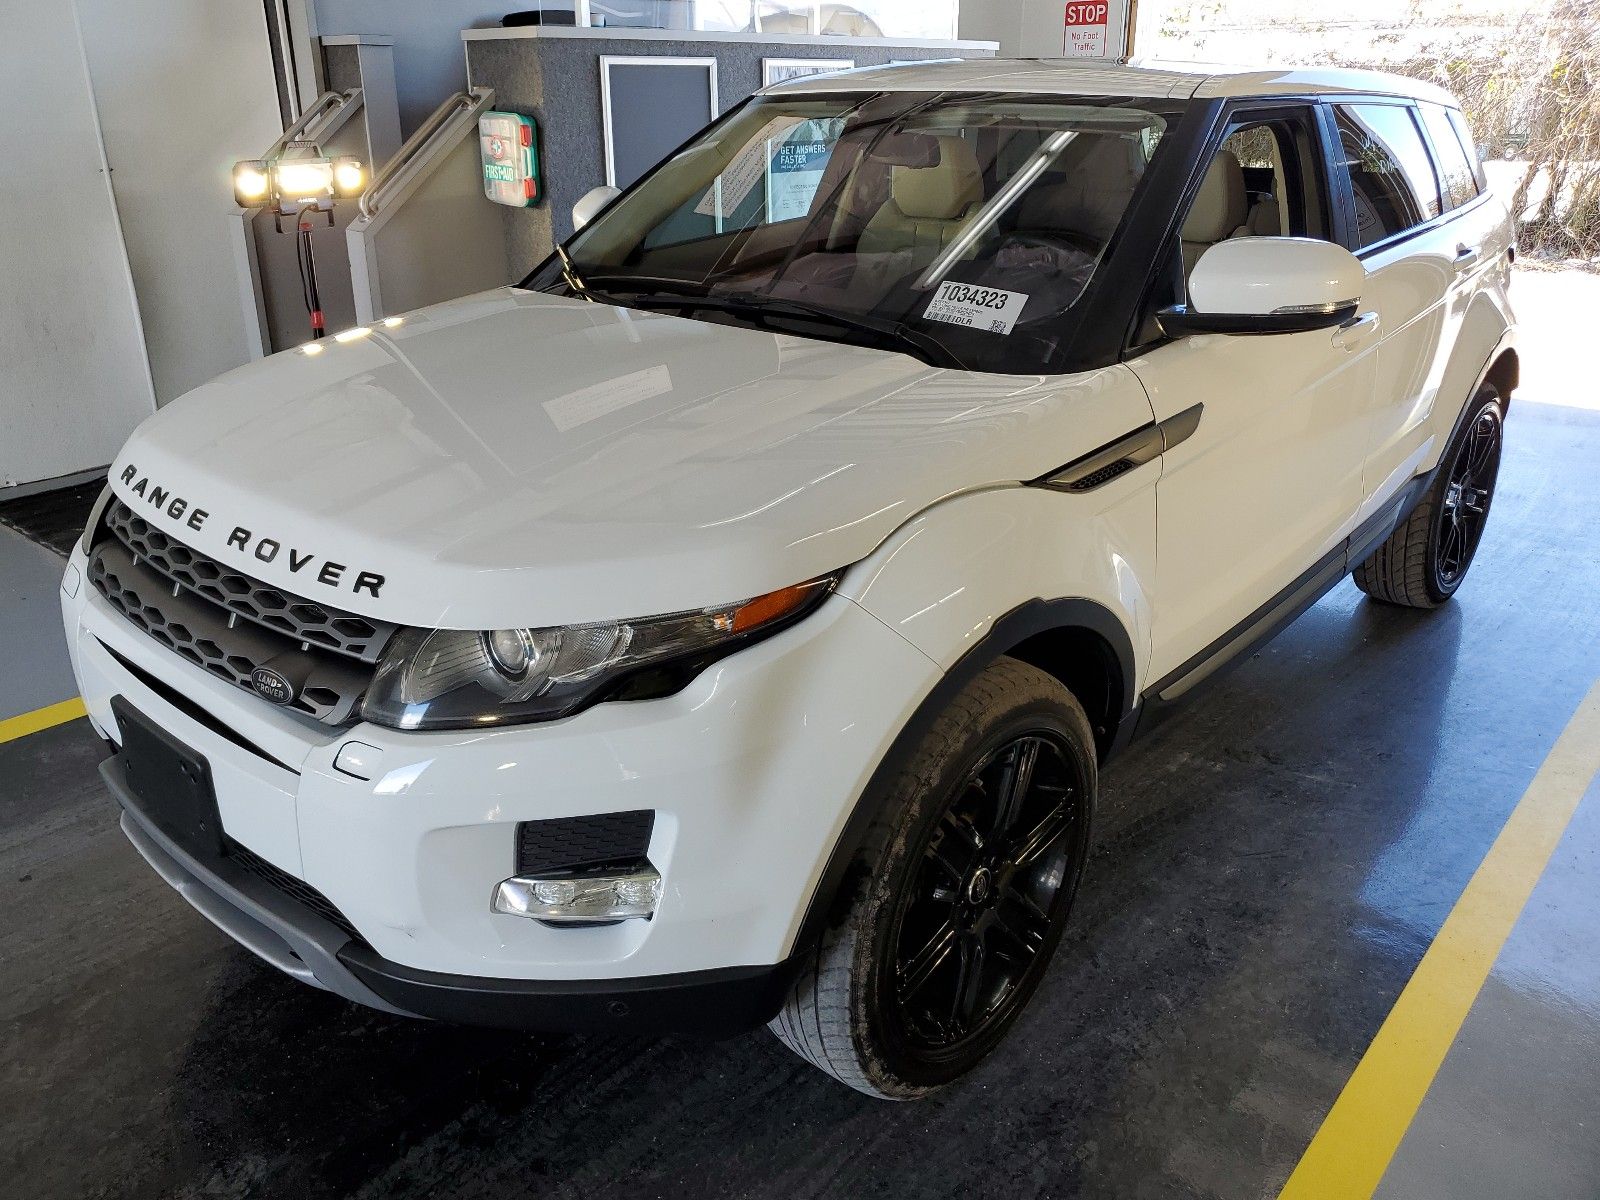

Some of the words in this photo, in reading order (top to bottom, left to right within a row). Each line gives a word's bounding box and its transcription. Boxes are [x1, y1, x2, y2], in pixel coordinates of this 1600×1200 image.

[1067, 4, 1106, 23] STOP
[1071, 32, 1081, 41] No
[1082, 31, 1099, 40] Foot
[1073, 42, 1096, 51] Traffic
[780, 145, 795, 155] GET
[796, 144, 826, 154] ANSWERS
[780, 155, 807, 164] FASTER
[940, 284, 1009, 310] 1034323
[120, 464, 210, 532] RANGE
[226, 526, 386, 599] ROVER
[257, 672, 278, 688] LAND
[260, 683, 284, 699] ROVER
